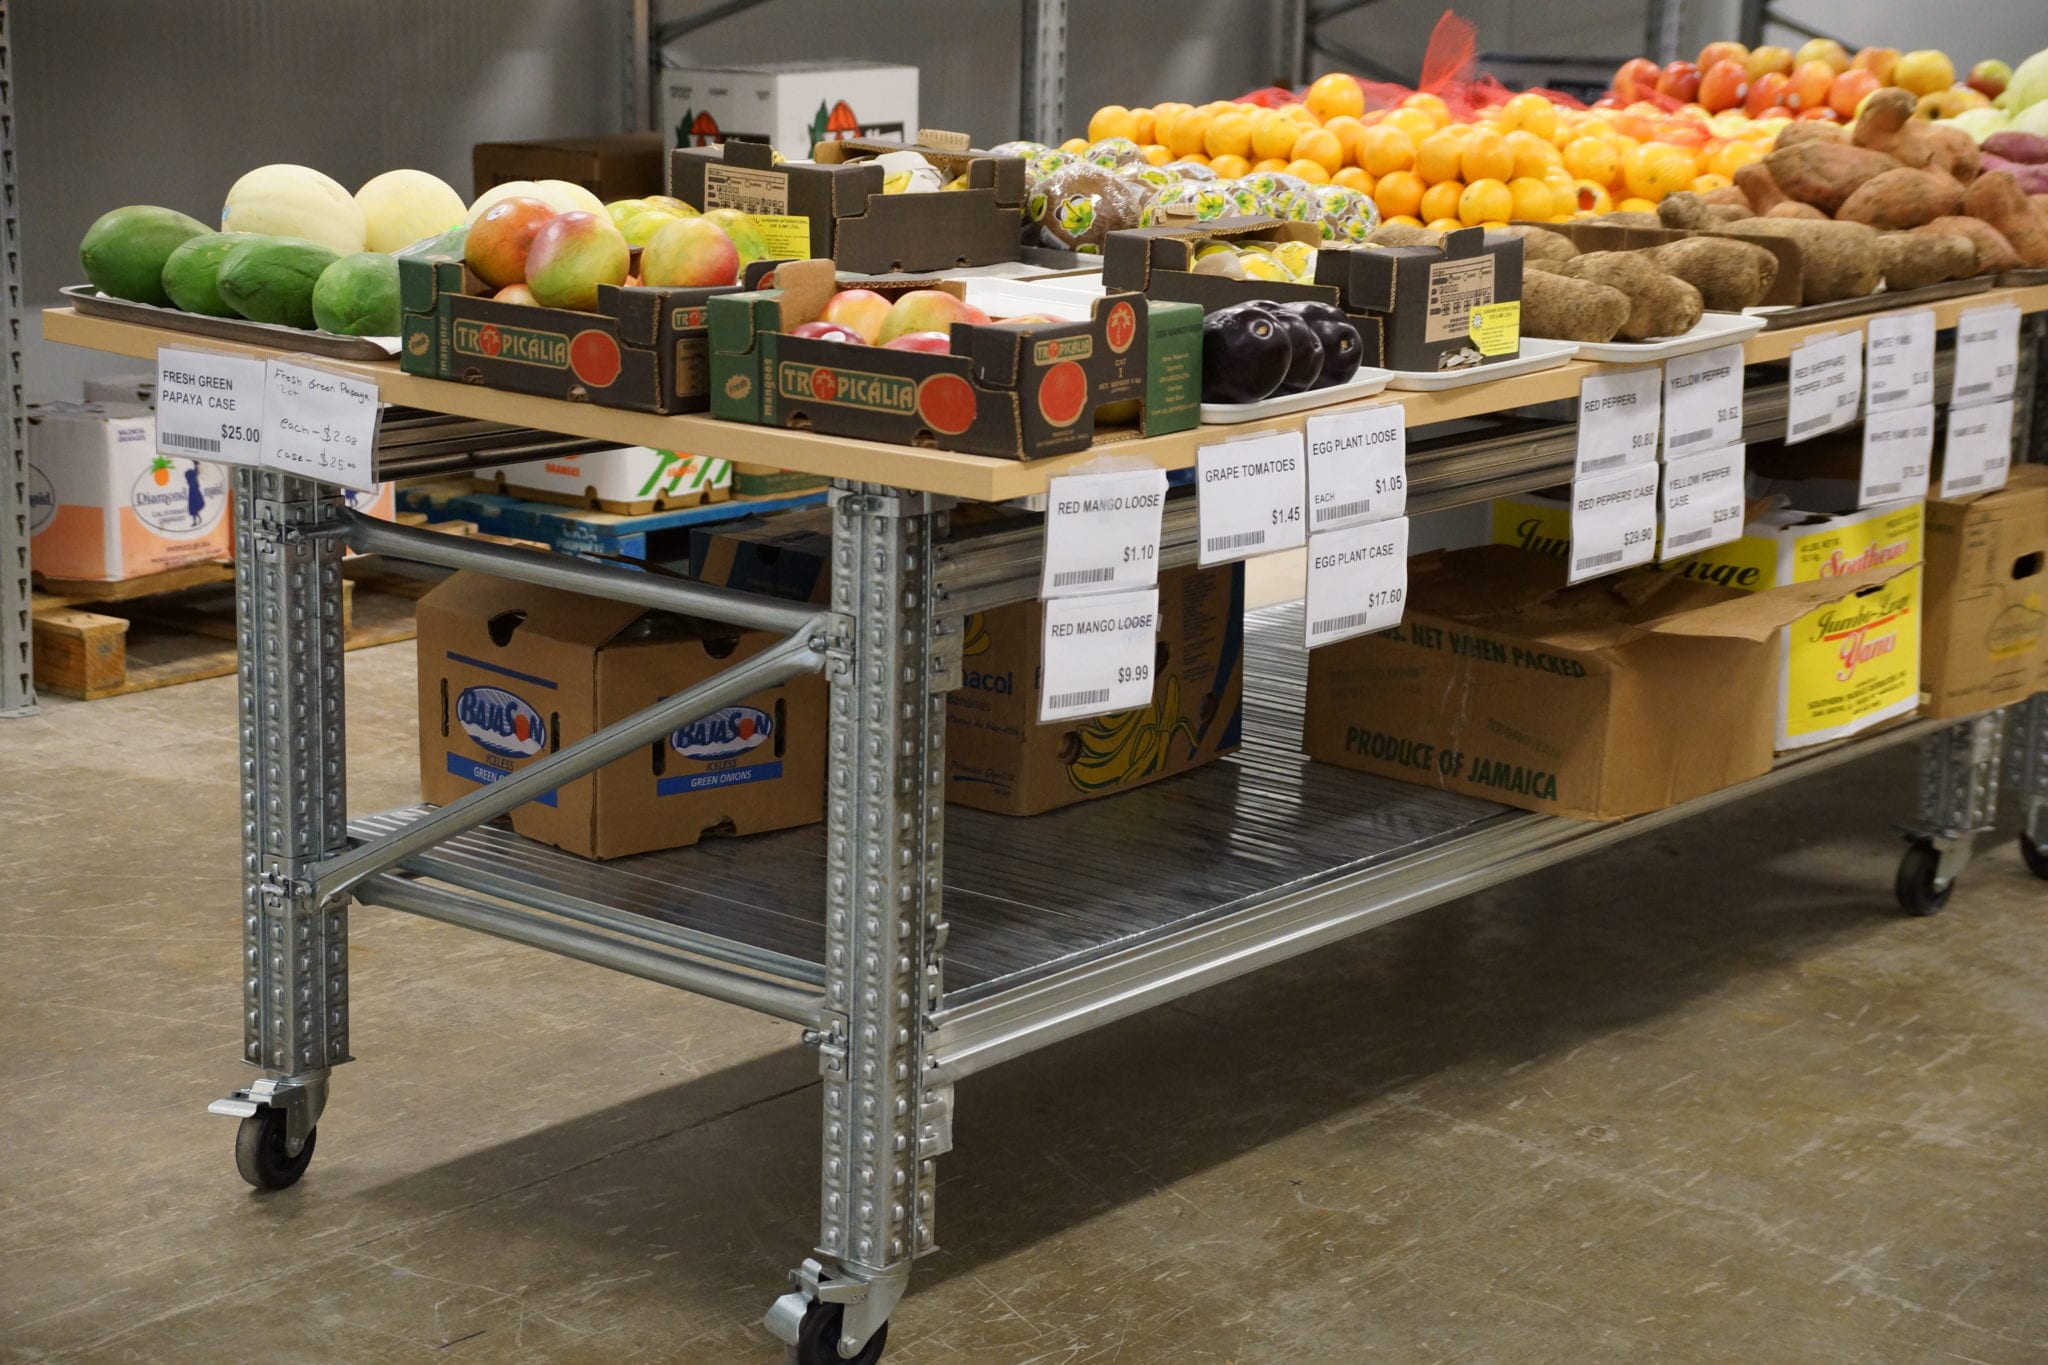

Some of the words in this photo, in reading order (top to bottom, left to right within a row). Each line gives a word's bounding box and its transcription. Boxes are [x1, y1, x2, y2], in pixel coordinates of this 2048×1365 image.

[439, 314, 449, 374] mangoes
[163, 370, 196, 386] FRESH
[198, 375, 233, 391] GREEN
[308, 379, 336, 393] Green
[764, 357, 776, 417] mangoes
[1671, 373, 1701, 389] YELLOW
[1702, 366, 1731, 382] PEPPER
[163, 390, 203, 407] PAPAYA
[208, 396, 236, 411] CASE
[1584, 400, 1601, 412] RED
[1602, 393, 1637, 410] PEPPERS
[221, 424, 260, 443] $25.00
[1313, 441, 1333, 456] EGG
[1335, 434, 1363, 451] PLANT
[1366, 429, 1397, 445] LOOSE
[1205, 466, 1240, 483] GRAPE
[1242, 458, 1296, 477] TOMATOES
[1669, 473, 1700, 490] YELLOW
[1702, 466, 1731, 482] PEPPER
[1375, 475, 1402, 494] $1.05
[136, 488, 188, 505] Diamond
[1058, 500, 1081, 515] RED
[1083, 496, 1123, 514] MANGO
[1125, 493, 1161, 510] LOOSE
[1315, 493, 1335, 504] EACH
[1577, 497, 1595, 511] RED
[1596, 489, 1633, 507] PEPPERS
[1634, 485, 1656, 499] CASE
[1669, 494, 1690, 509] CASE
[1271, 507, 1301, 525] $1.45
[1624, 528, 1653, 546] $29.90
[1123, 544, 1154, 563] $1.10
[1315, 555, 1336, 569] EGG
[1338, 548, 1367, 565] PLANT
[1369, 543, 1394, 558] CASE
[1368, 588, 1402, 608] $17.60
[1051, 624, 1074, 638] RED
[1076, 619, 1116, 636] MANGO
[1118, 614, 1153, 630] LOOSE
[1412, 624, 1443, 651] NET
[1449, 631, 1506, 664] WHEN
[1512, 646, 1586, 679] PACKED
[1118, 665, 1149, 684] $9.99
[486, 753, 514, 771] ICELESS
[706, 758, 738, 772] ICELESS
[1346, 726, 1433, 772] PRODUCE
[1438, 748, 1465, 779] OF
[1468, 757, 1558, 801] JAMAICA
[473, 766, 497, 783] GREEN
[690, 773, 719, 789] GREEN
[720, 769, 752, 785] ONIONS
